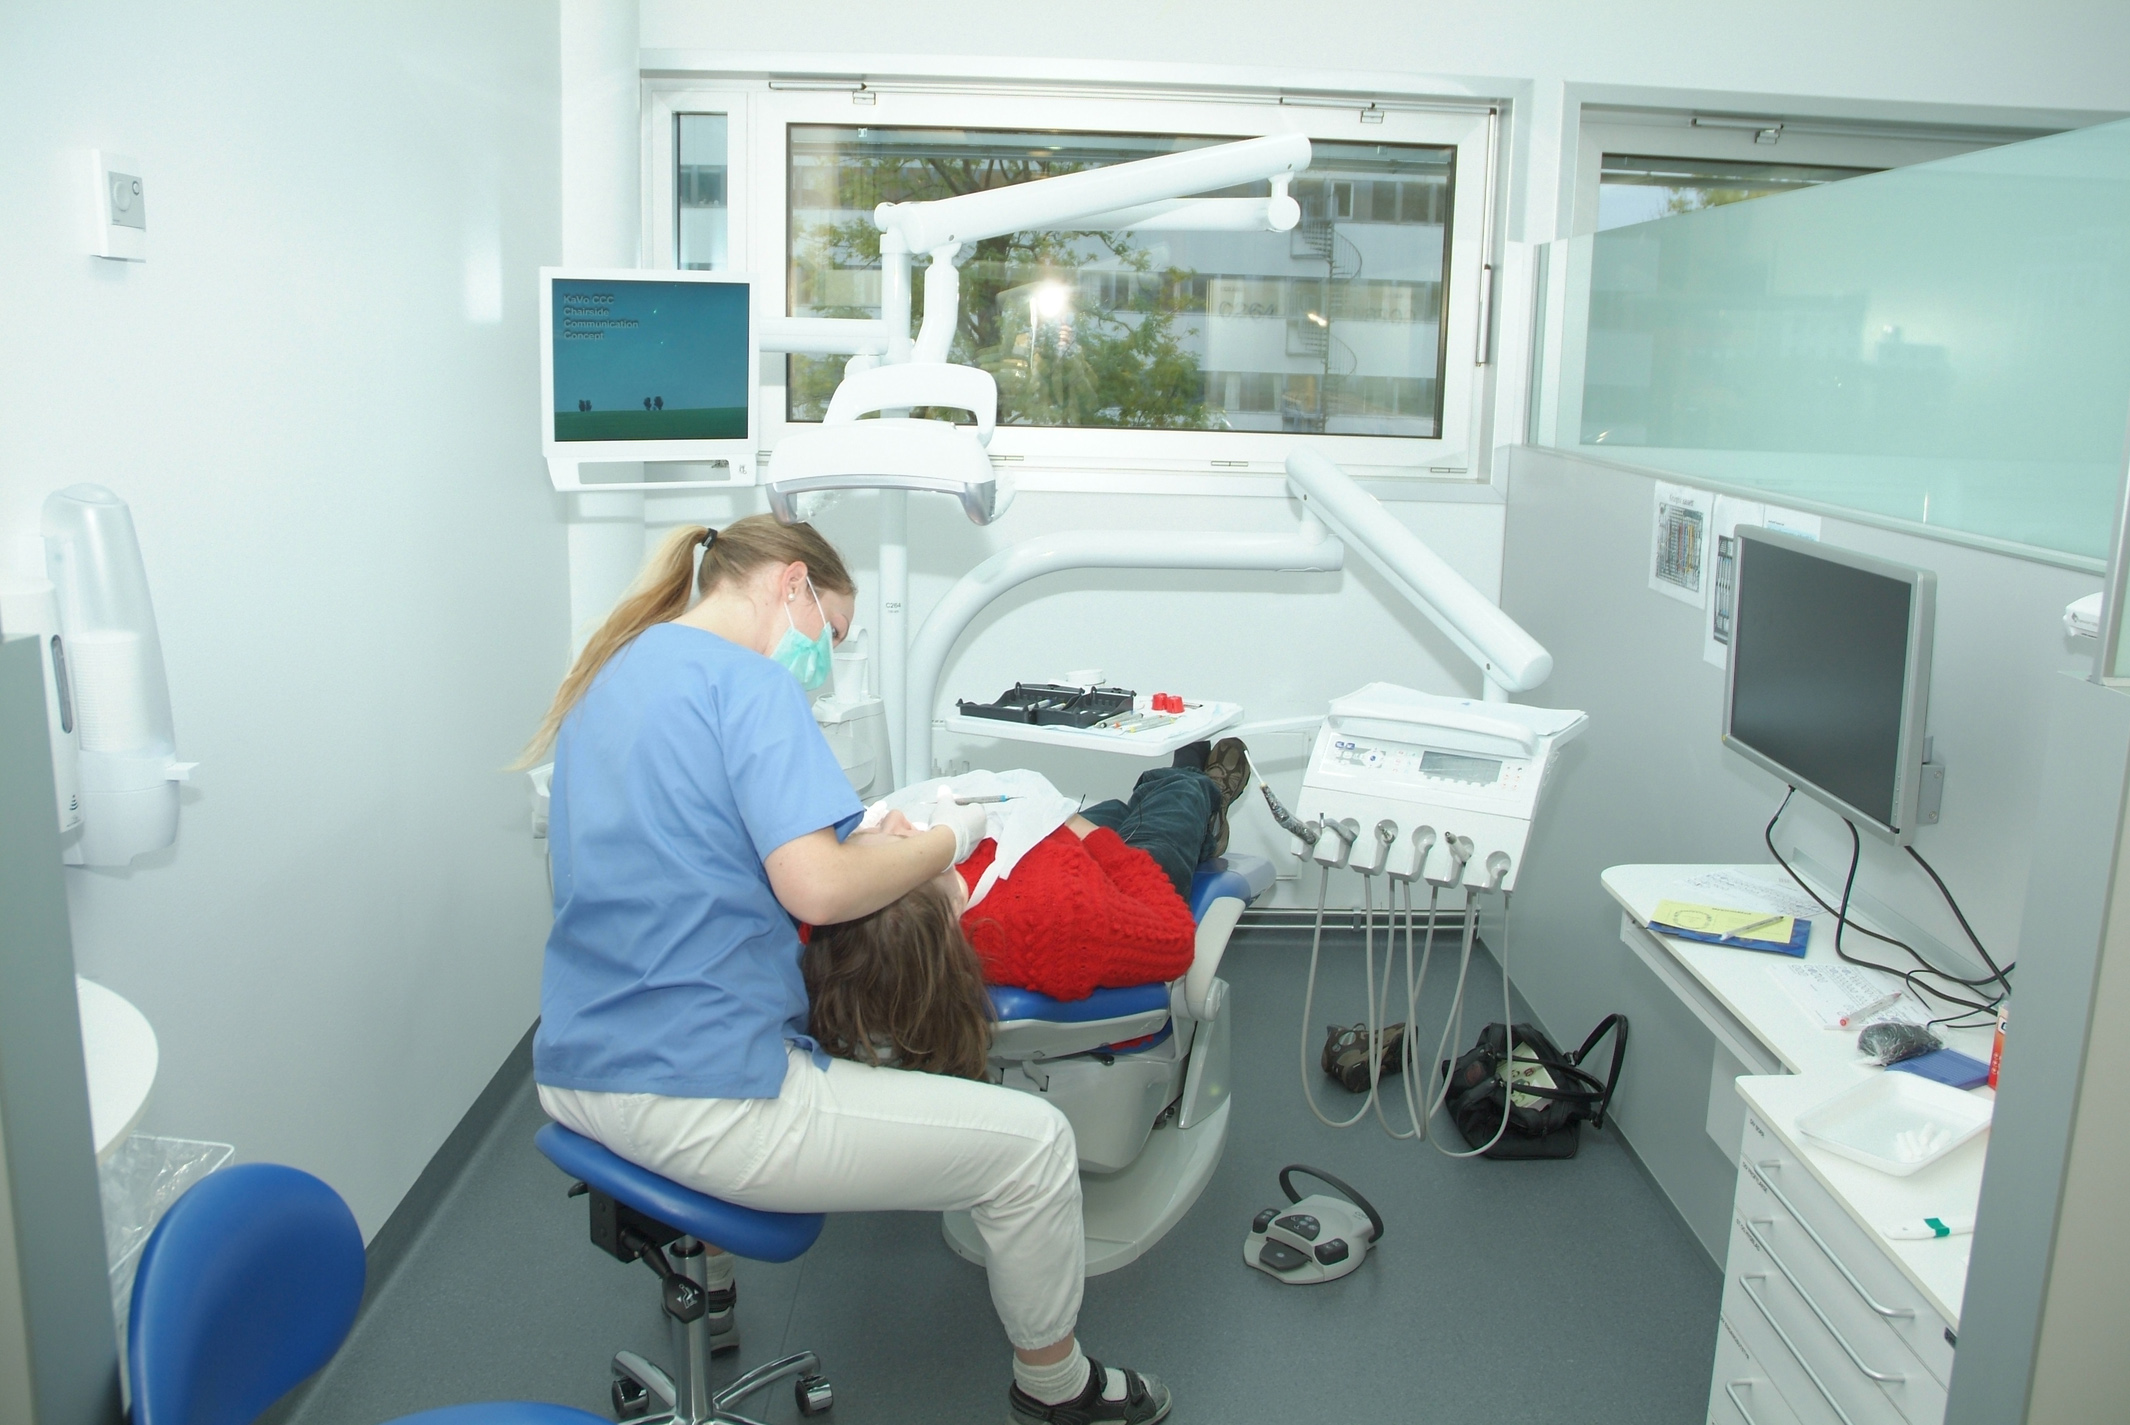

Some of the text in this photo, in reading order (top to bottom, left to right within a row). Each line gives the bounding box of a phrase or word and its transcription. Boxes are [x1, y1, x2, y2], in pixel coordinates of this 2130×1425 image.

[563, 295, 615, 304] KaVo CCC
[563, 307, 610, 316] Chairside
[563, 319, 639, 329] Communication
[563, 331, 604, 341] Concept
